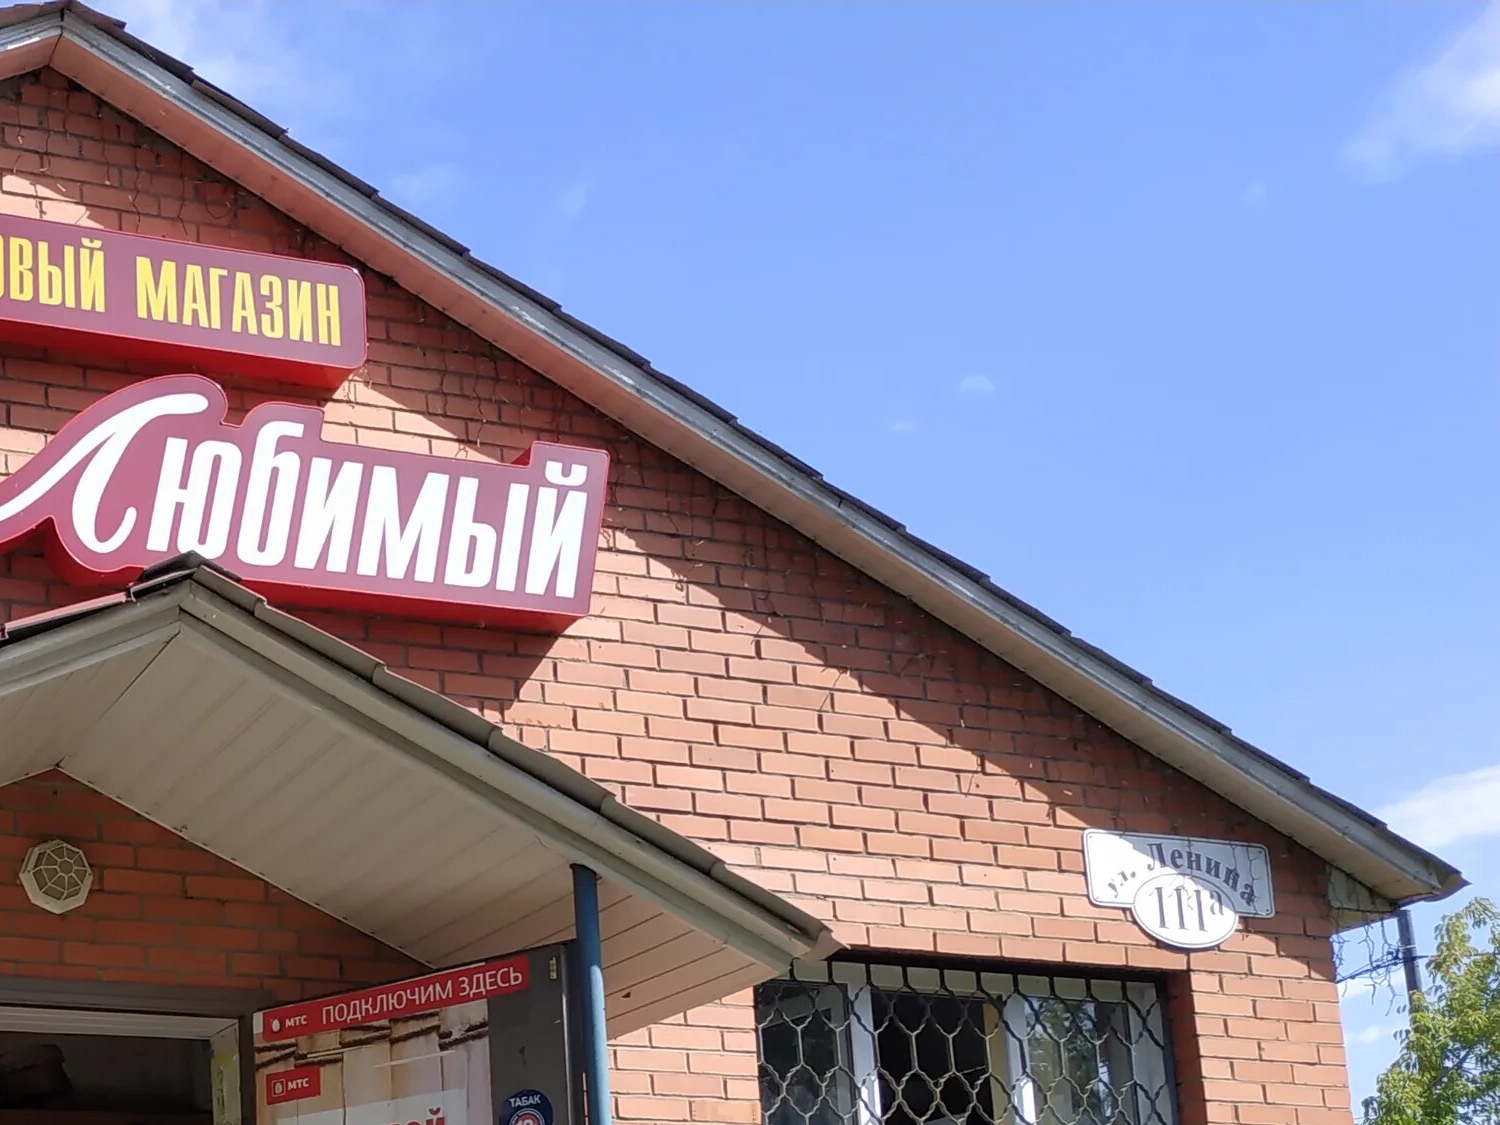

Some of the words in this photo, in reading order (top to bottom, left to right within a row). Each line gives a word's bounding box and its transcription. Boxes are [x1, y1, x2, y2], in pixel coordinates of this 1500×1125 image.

[136, 256, 341, 347] МАГАЗИН
[1107, 869, 1136, 898] ул.
[1147, 843, 1256, 906] Ленина
[285, 1015, 307, 1028] МТС
[322, 982, 452, 1024] ПОДКЛЮЧИМ
[459, 967, 522, 999] ЗДЕСЬ
[288, 1078, 309, 1091] МТС
[509, 1094, 541, 1107] ТАБАК
